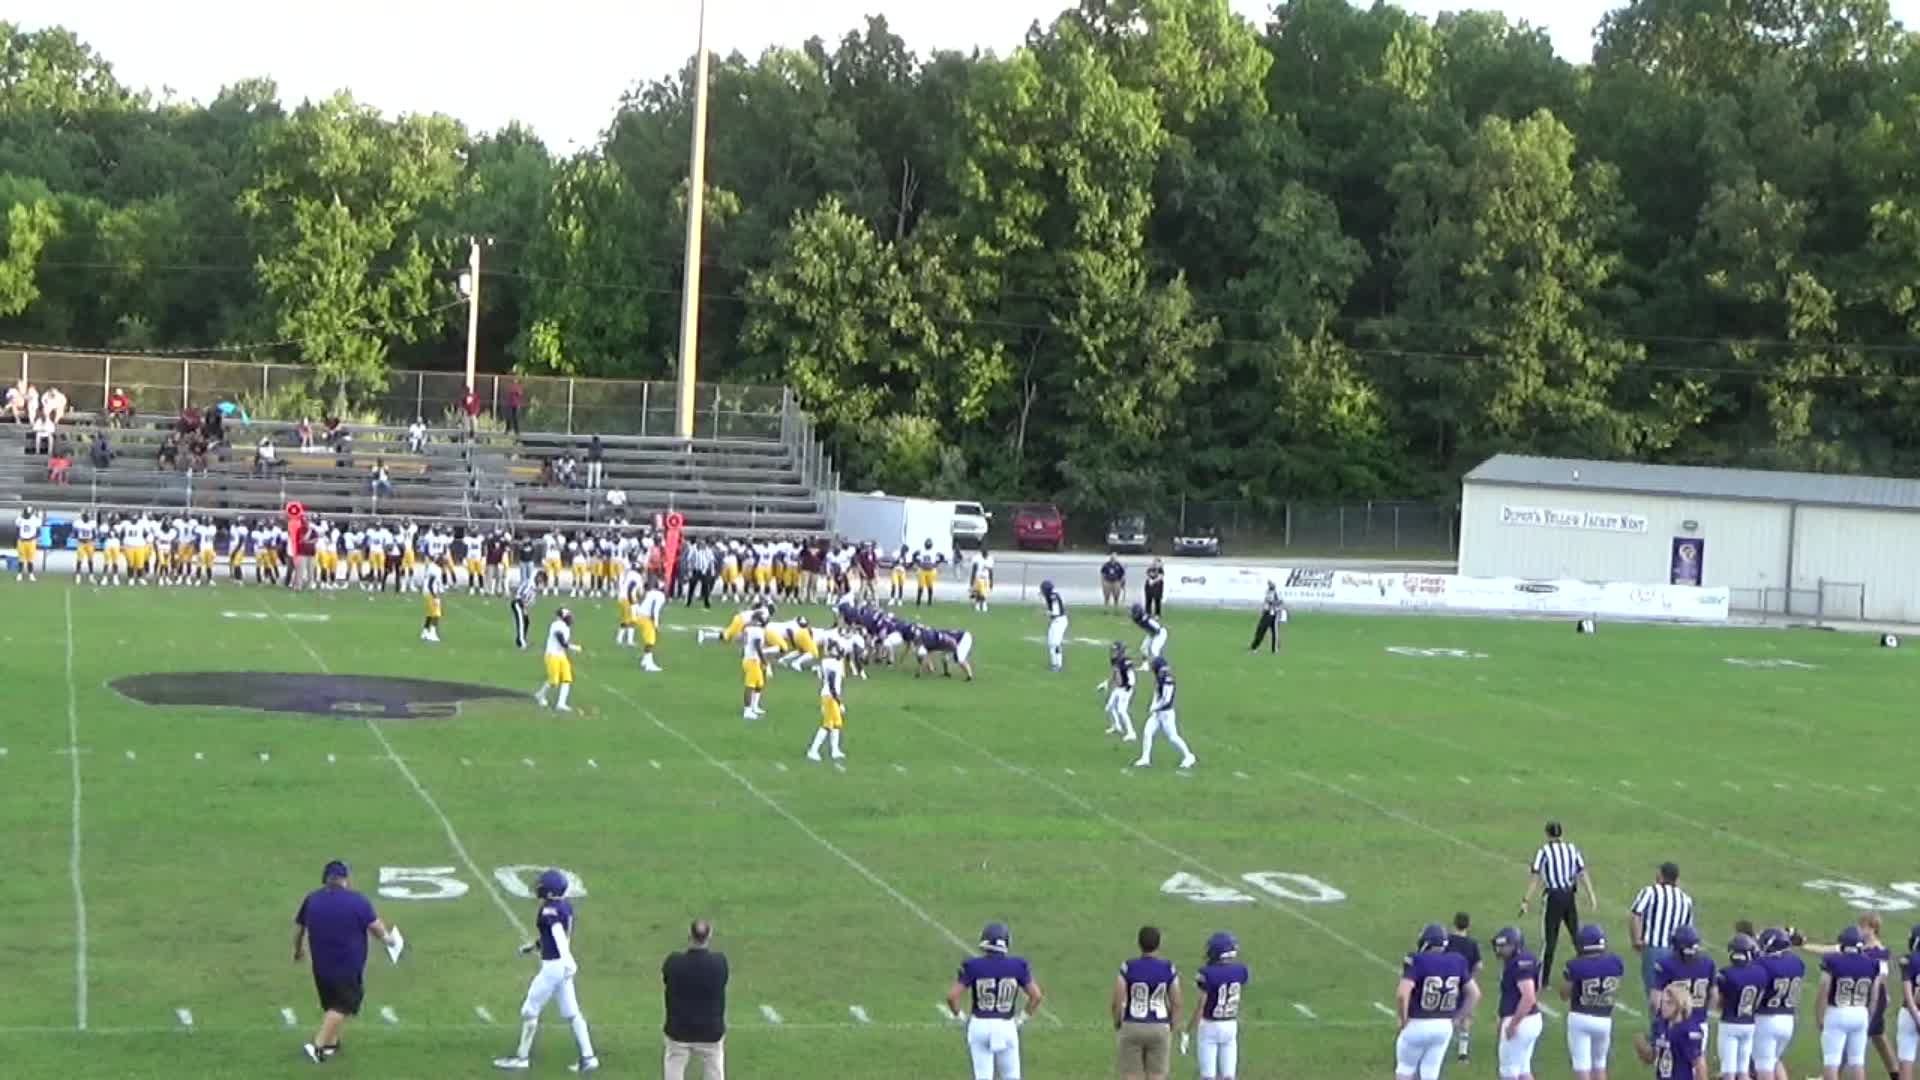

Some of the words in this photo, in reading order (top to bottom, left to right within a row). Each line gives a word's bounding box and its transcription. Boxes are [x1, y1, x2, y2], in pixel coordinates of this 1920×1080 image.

[376, 864, 588, 900] 50
[1160, 871, 1347, 902] 40
[976, 977, 1018, 1012] 50
[1129, 982, 1169, 1019] 84
[1420, 976, 1461, 1012] 62
[1579, 976, 1620, 1007] 52
[1835, 977, 1873, 1009] 69
